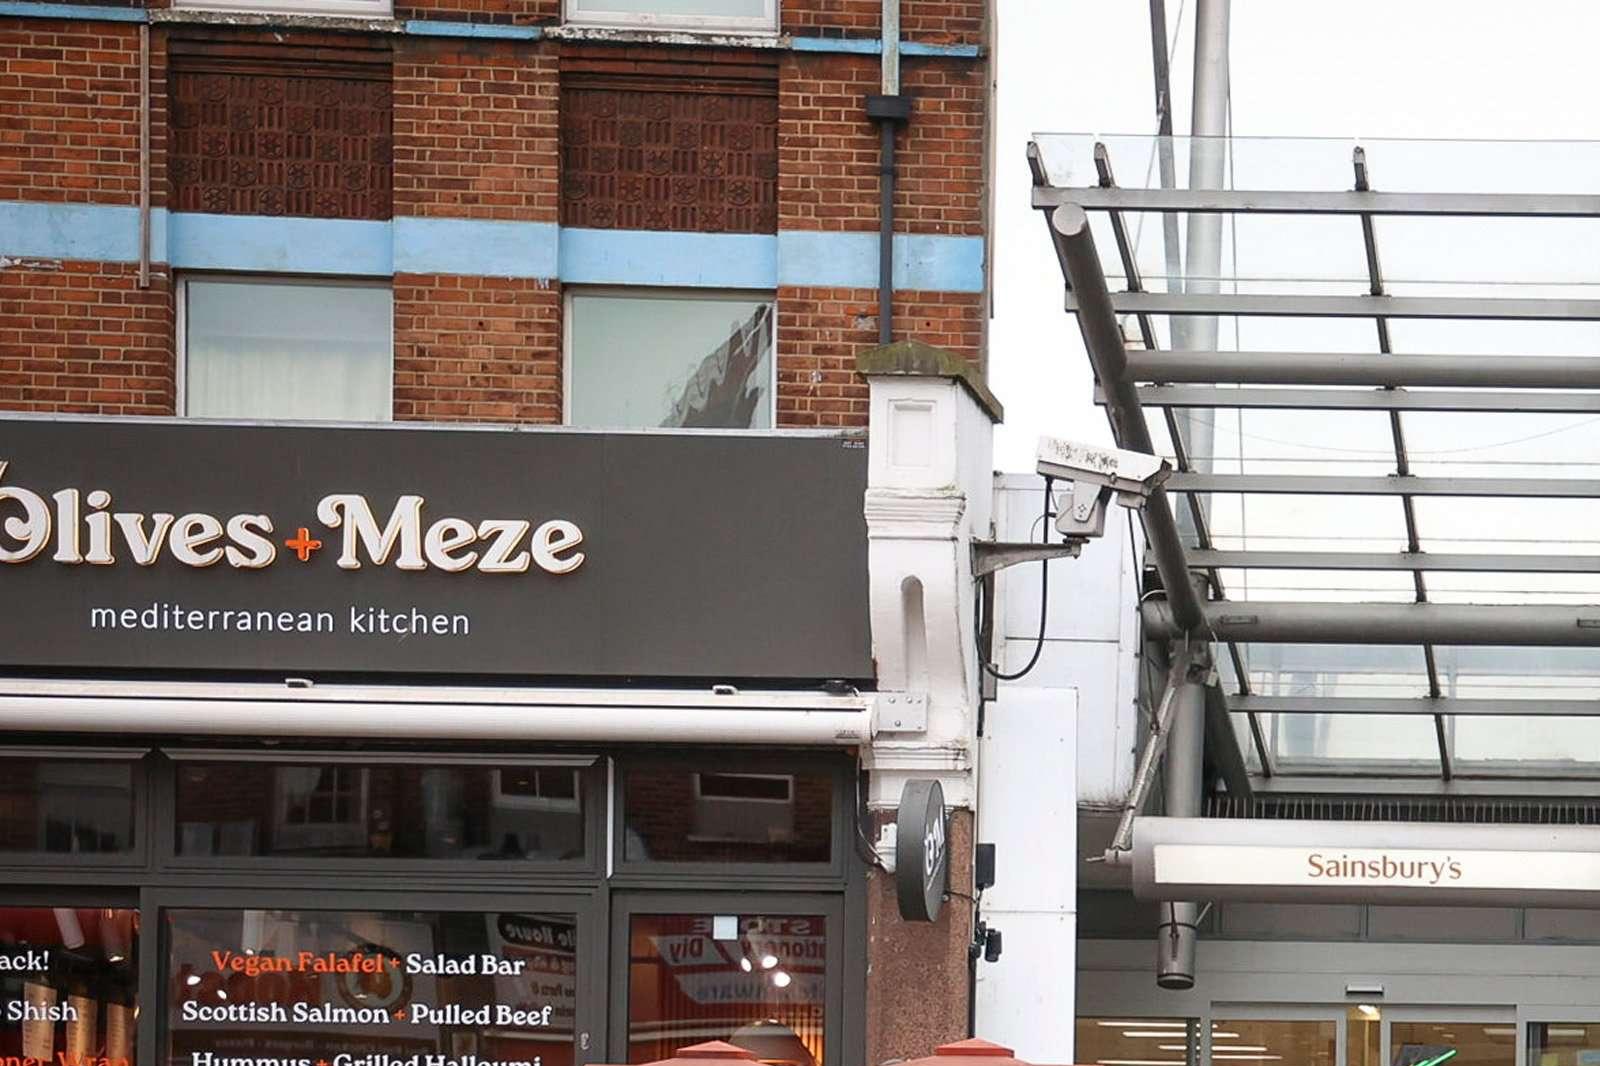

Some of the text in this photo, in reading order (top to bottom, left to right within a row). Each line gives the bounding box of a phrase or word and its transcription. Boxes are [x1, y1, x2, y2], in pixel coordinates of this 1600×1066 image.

[0, 486, 277, 568] Olives
[317, 494, 586, 574] Meze
[90, 602, 470, 634] mediterranean kitchen
[1307, 854, 1462, 884] Sainsbury's
[211, 951, 293, 976] Vegan
[298, 952, 384, 974] Falafel
[405, 954, 477, 975] Salad
[481, 954, 526, 975] Bar
[7, 1001, 78, 1020] Shish
[182, 1001, 288, 1023] Scottish
[292, 1003, 389, 1024] Salmon
[411, 1004, 491, 1026] Pulled
[495, 1005, 552, 1027] Beef
